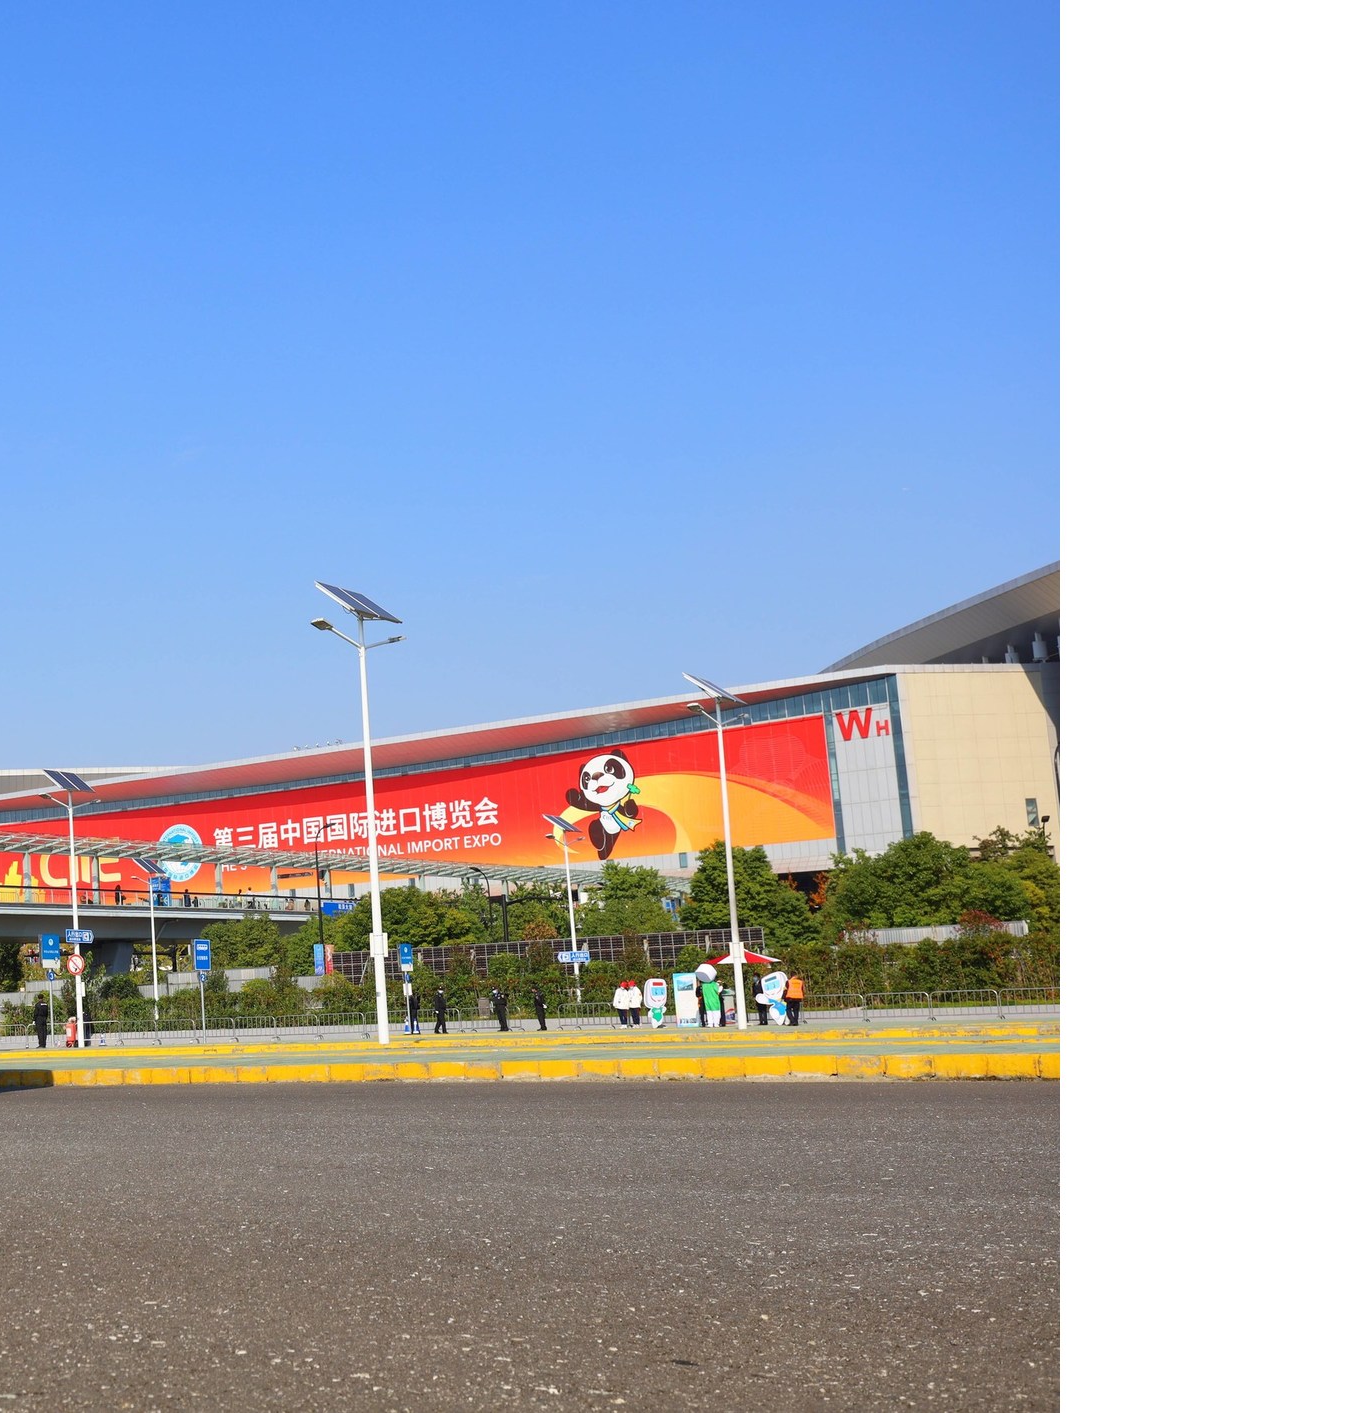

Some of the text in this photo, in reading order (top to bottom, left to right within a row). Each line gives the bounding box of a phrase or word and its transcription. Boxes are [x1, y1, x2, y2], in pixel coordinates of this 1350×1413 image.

[213, 797, 499, 848] 第三届中国国际进口博览会
[407, 838, 459, 853] IMPORT
[464, 833, 502, 848] EXPO
